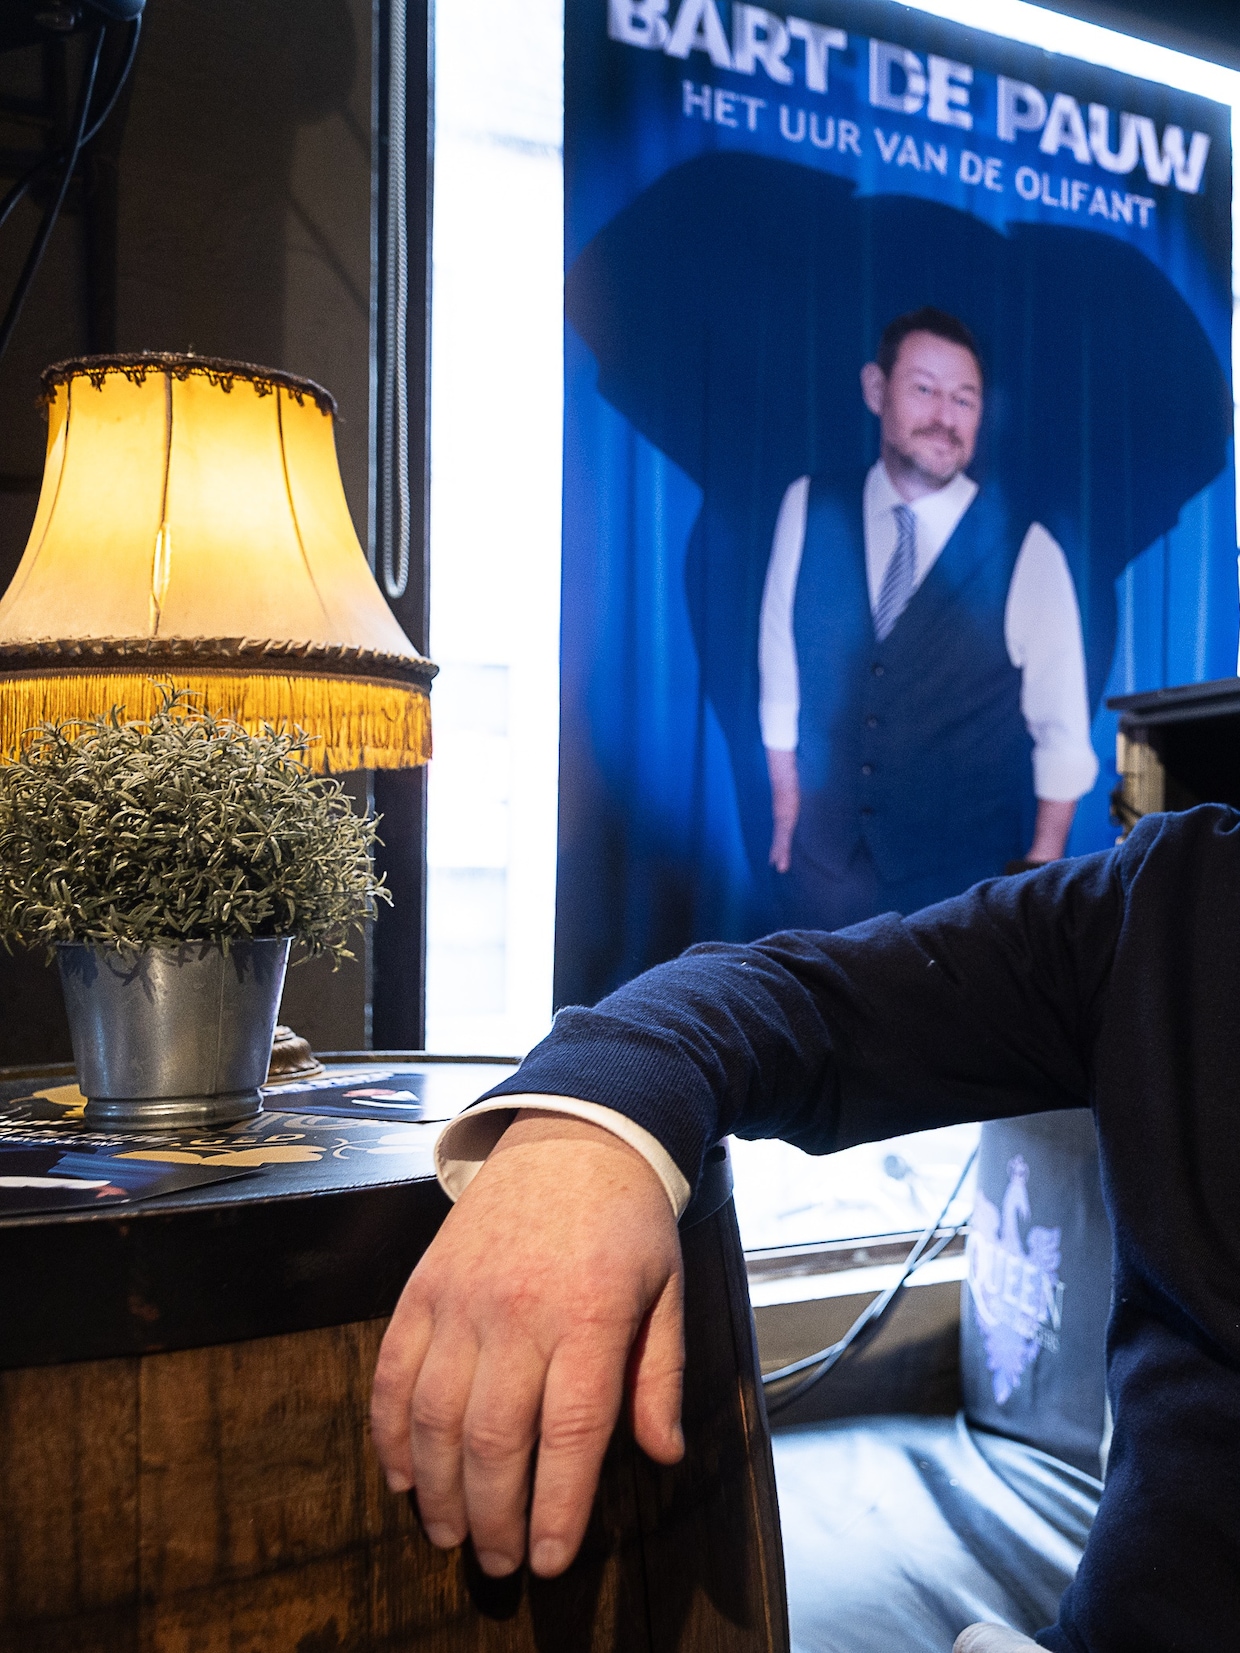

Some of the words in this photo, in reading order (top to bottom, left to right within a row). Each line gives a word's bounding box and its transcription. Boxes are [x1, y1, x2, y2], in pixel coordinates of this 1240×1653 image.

[606, 0, 848, 95] BART
[868, 37, 974, 131] DE
[996, 75, 1212, 194] PAUW
[682, 80, 767, 132] HET
[779, 102, 862, 157] UUR
[874, 128, 949, 177] VAN
[958, 149, 1005, 191] DE
[1014, 164, 1156, 229] OLIFANT
